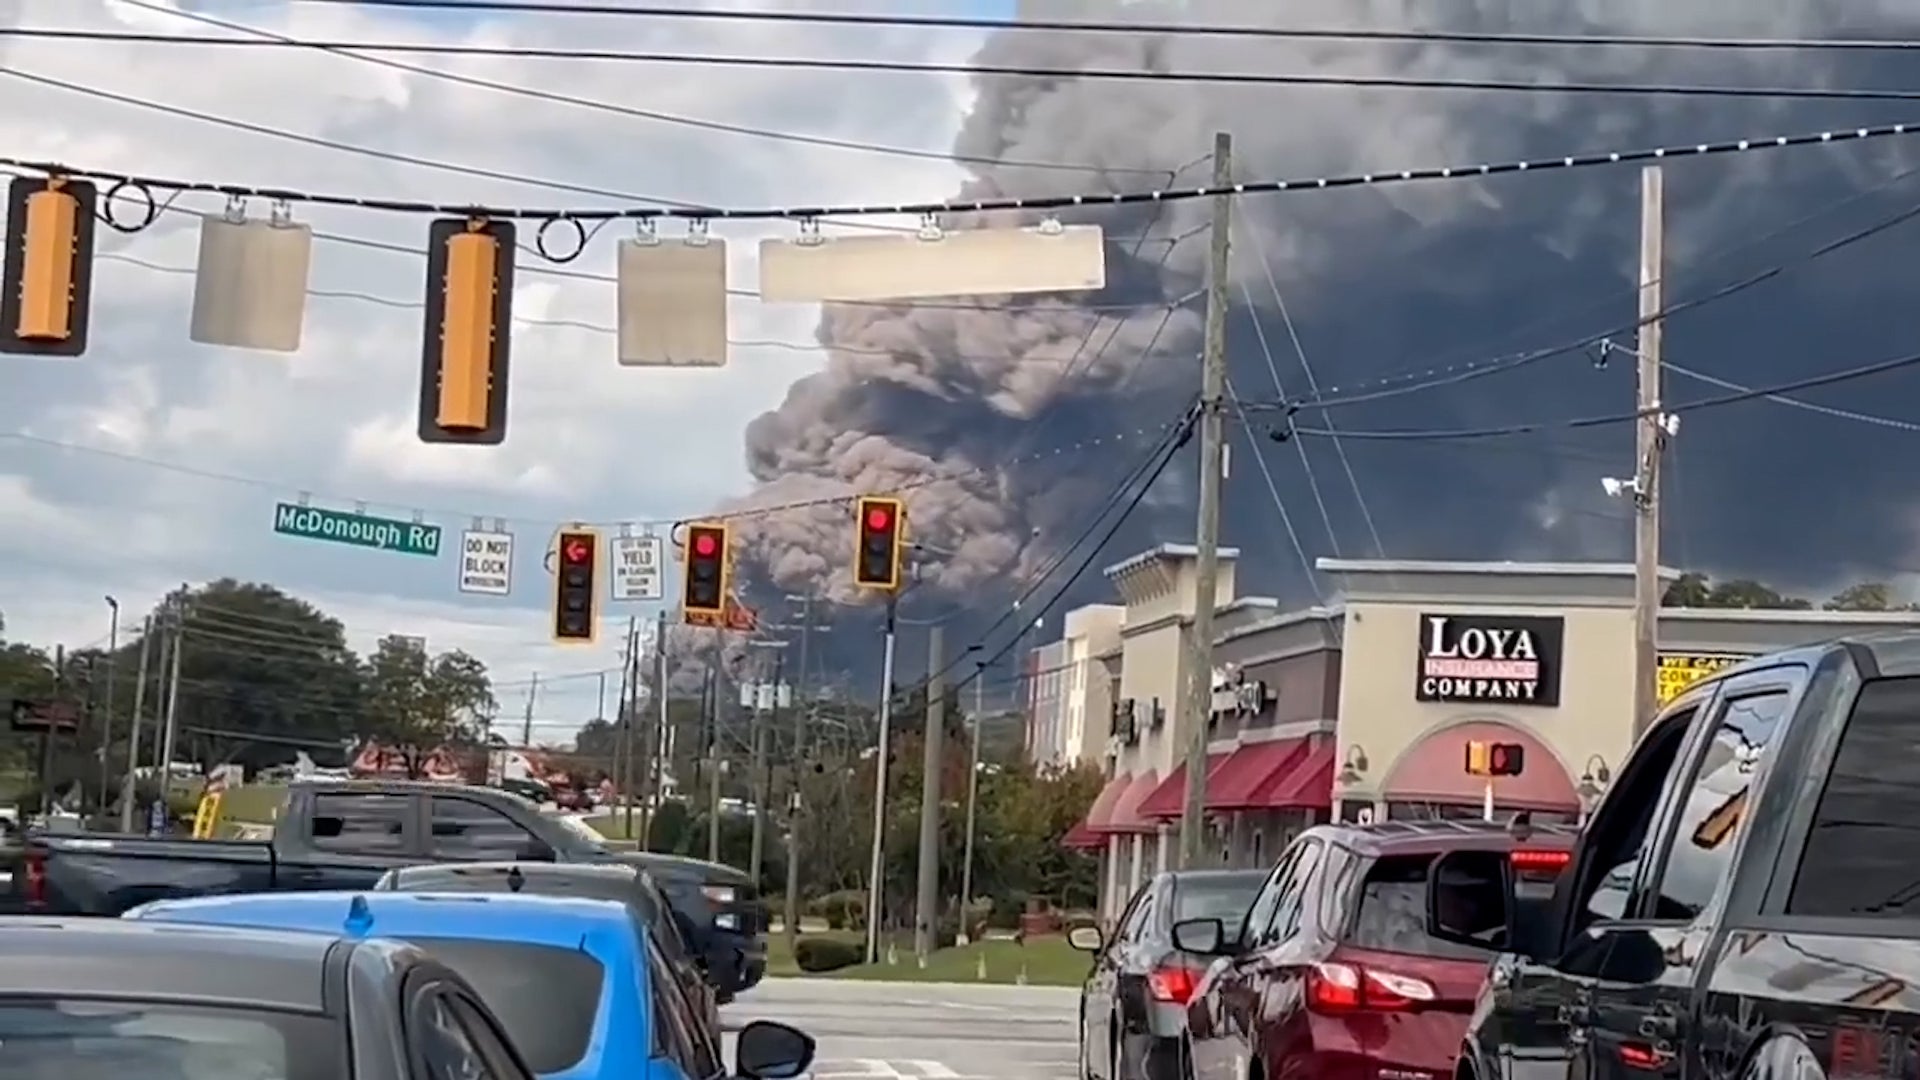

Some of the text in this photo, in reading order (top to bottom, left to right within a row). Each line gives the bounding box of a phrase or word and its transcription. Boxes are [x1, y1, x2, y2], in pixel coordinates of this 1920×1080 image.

[277, 506, 439, 550] McDonough Rd
[466, 538, 508, 555] DO NOT
[465, 556, 506, 574] BLOCK
[622, 550, 652, 566] YIELD
[1427, 616, 1538, 660] LOYA
[1422, 678, 1538, 699] COMPANY
